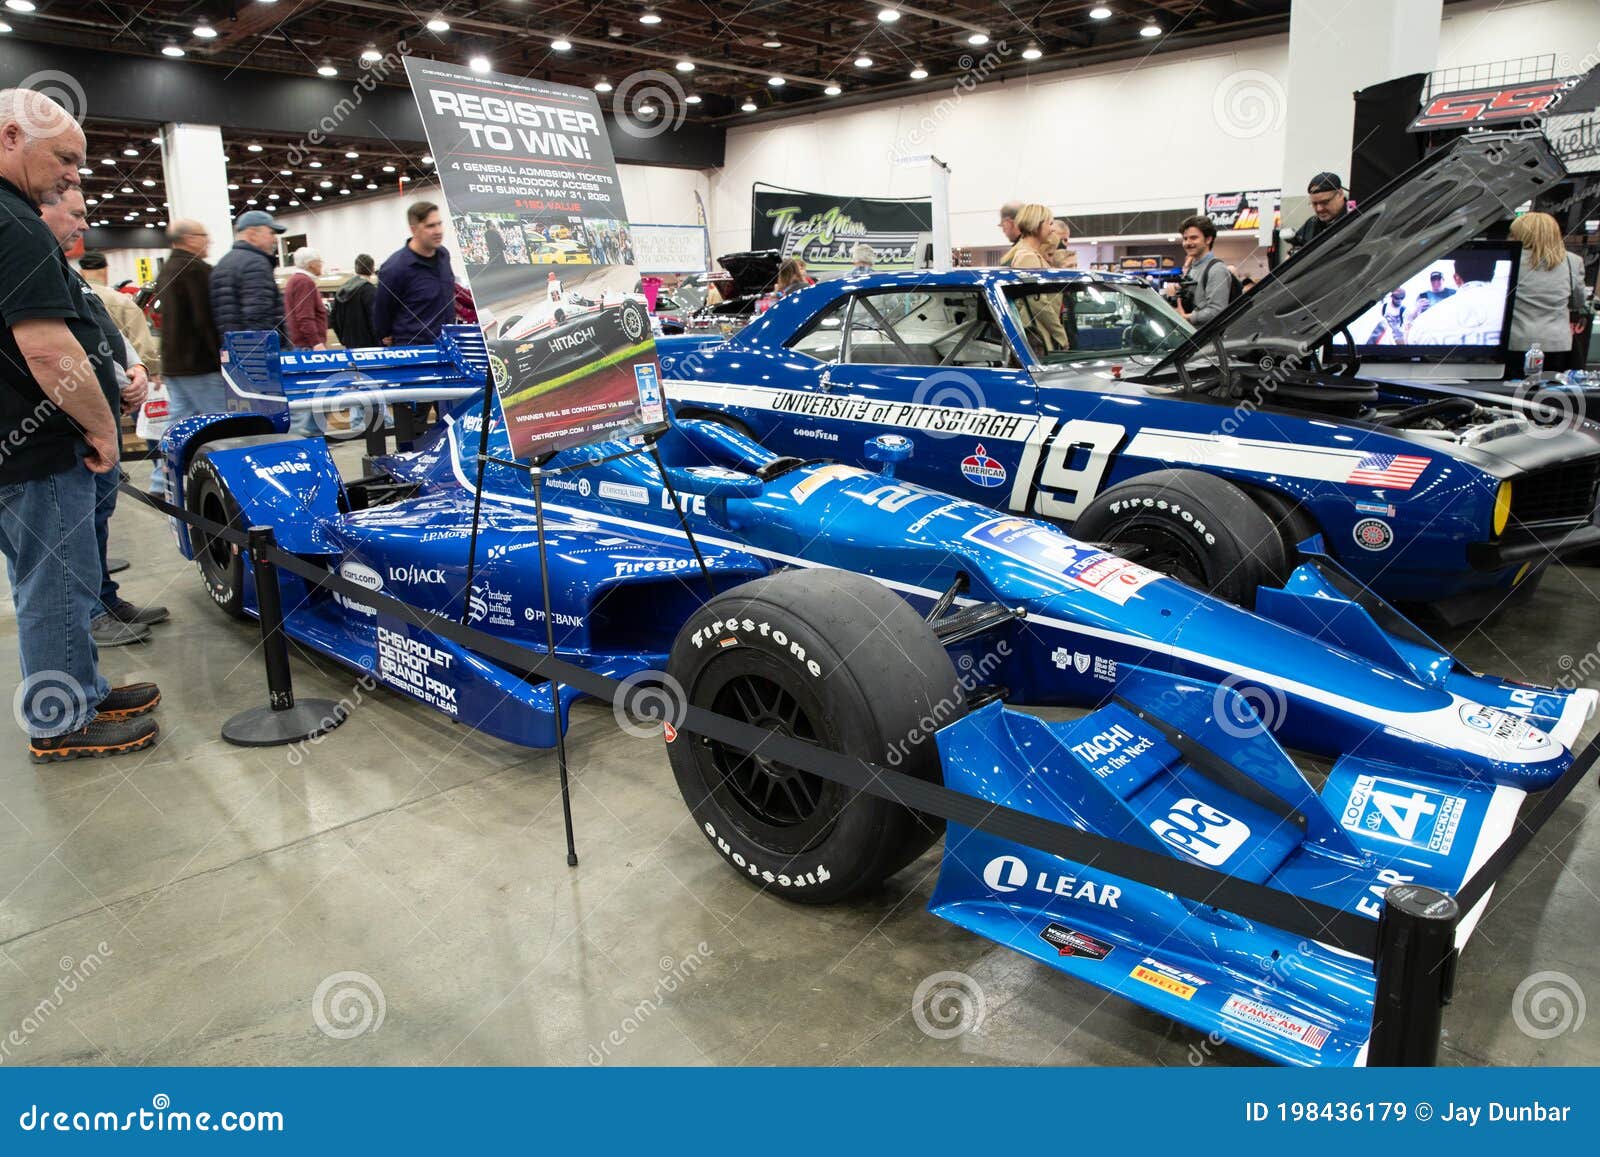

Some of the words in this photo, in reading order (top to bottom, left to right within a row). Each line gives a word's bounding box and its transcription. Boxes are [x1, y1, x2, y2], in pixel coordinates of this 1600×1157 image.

[429, 89, 600, 135] REGISTER
[460, 121, 514, 151] TO
[516, 128, 592, 160] WIN!
[452, 162, 460, 171] 4
[463, 162, 518, 175] GENERAL
[519, 166, 575, 180] ADMISSION
[576, 172, 613, 185] TICKETS
[478, 174, 506, 184] WITH
[509, 176, 559, 188] PADDOCK
[562, 181, 600, 192] ACCESS
[469, 184, 494, 194] FOR
[496, 185, 544, 198] SUNDAY,
[545, 188, 567, 198] MAY
[570, 190, 586, 200] 31,
[588, 192, 610, 202] 2020
[546, 201, 582, 212] VALUE
[791, 233, 917, 264] Custms
[548, 326, 596, 352] HITACHI
[280, 354, 297, 365] E
[301, 352, 348, 364] LOVE
[352, 349, 421, 362] DETROIT
[516, 412, 544, 423] WINNER
[545, 409, 560, 418] WILL
[562, 408, 570, 416] BE
[572, 403, 606, 414] CONTACTED
[618, 400, 634, 408] EMAIL
[872, 403, 894, 424] of
[895, 405, 1020, 438] PITTSBURGH
[793, 428, 839, 442] GOODYEAR
[257, 460, 312, 477] meijer
[962, 464, 1006, 479] AMERICAN
[1008, 416, 1126, 522] 19
[545, 477, 578, 492] Autotrader
[661, 487, 706, 517] DTE
[420, 529, 484, 544] J.P.Morgn
[1109, 497, 1216, 545] Firestone
[343, 570, 376, 585] cars.com
[614, 556, 715, 577] Firestone
[377, 627, 453, 669] CHEVROLET
[378, 643, 430, 673] DETROIT
[690, 617, 822, 678] Firestone
[380, 656, 424, 687] GRAND
[426, 677, 457, 704] PRIX
[382, 672, 424, 698] PRESENTED
[424, 692, 437, 704] BY
[436, 698, 458, 715] LEAR
[1107, 755, 1131, 770] the
[1122, 736, 1155, 758] Next
[1343, 778, 1373, 827] LOCAL
[1373, 790, 1438, 840] 4
[704, 821, 831, 888] Firestone
[1035, 872, 1122, 908] LEAR
[1232, 1000, 1302, 1033] TRANS-AM
[1248, 1000, 1290, 1020] HISTORIC
